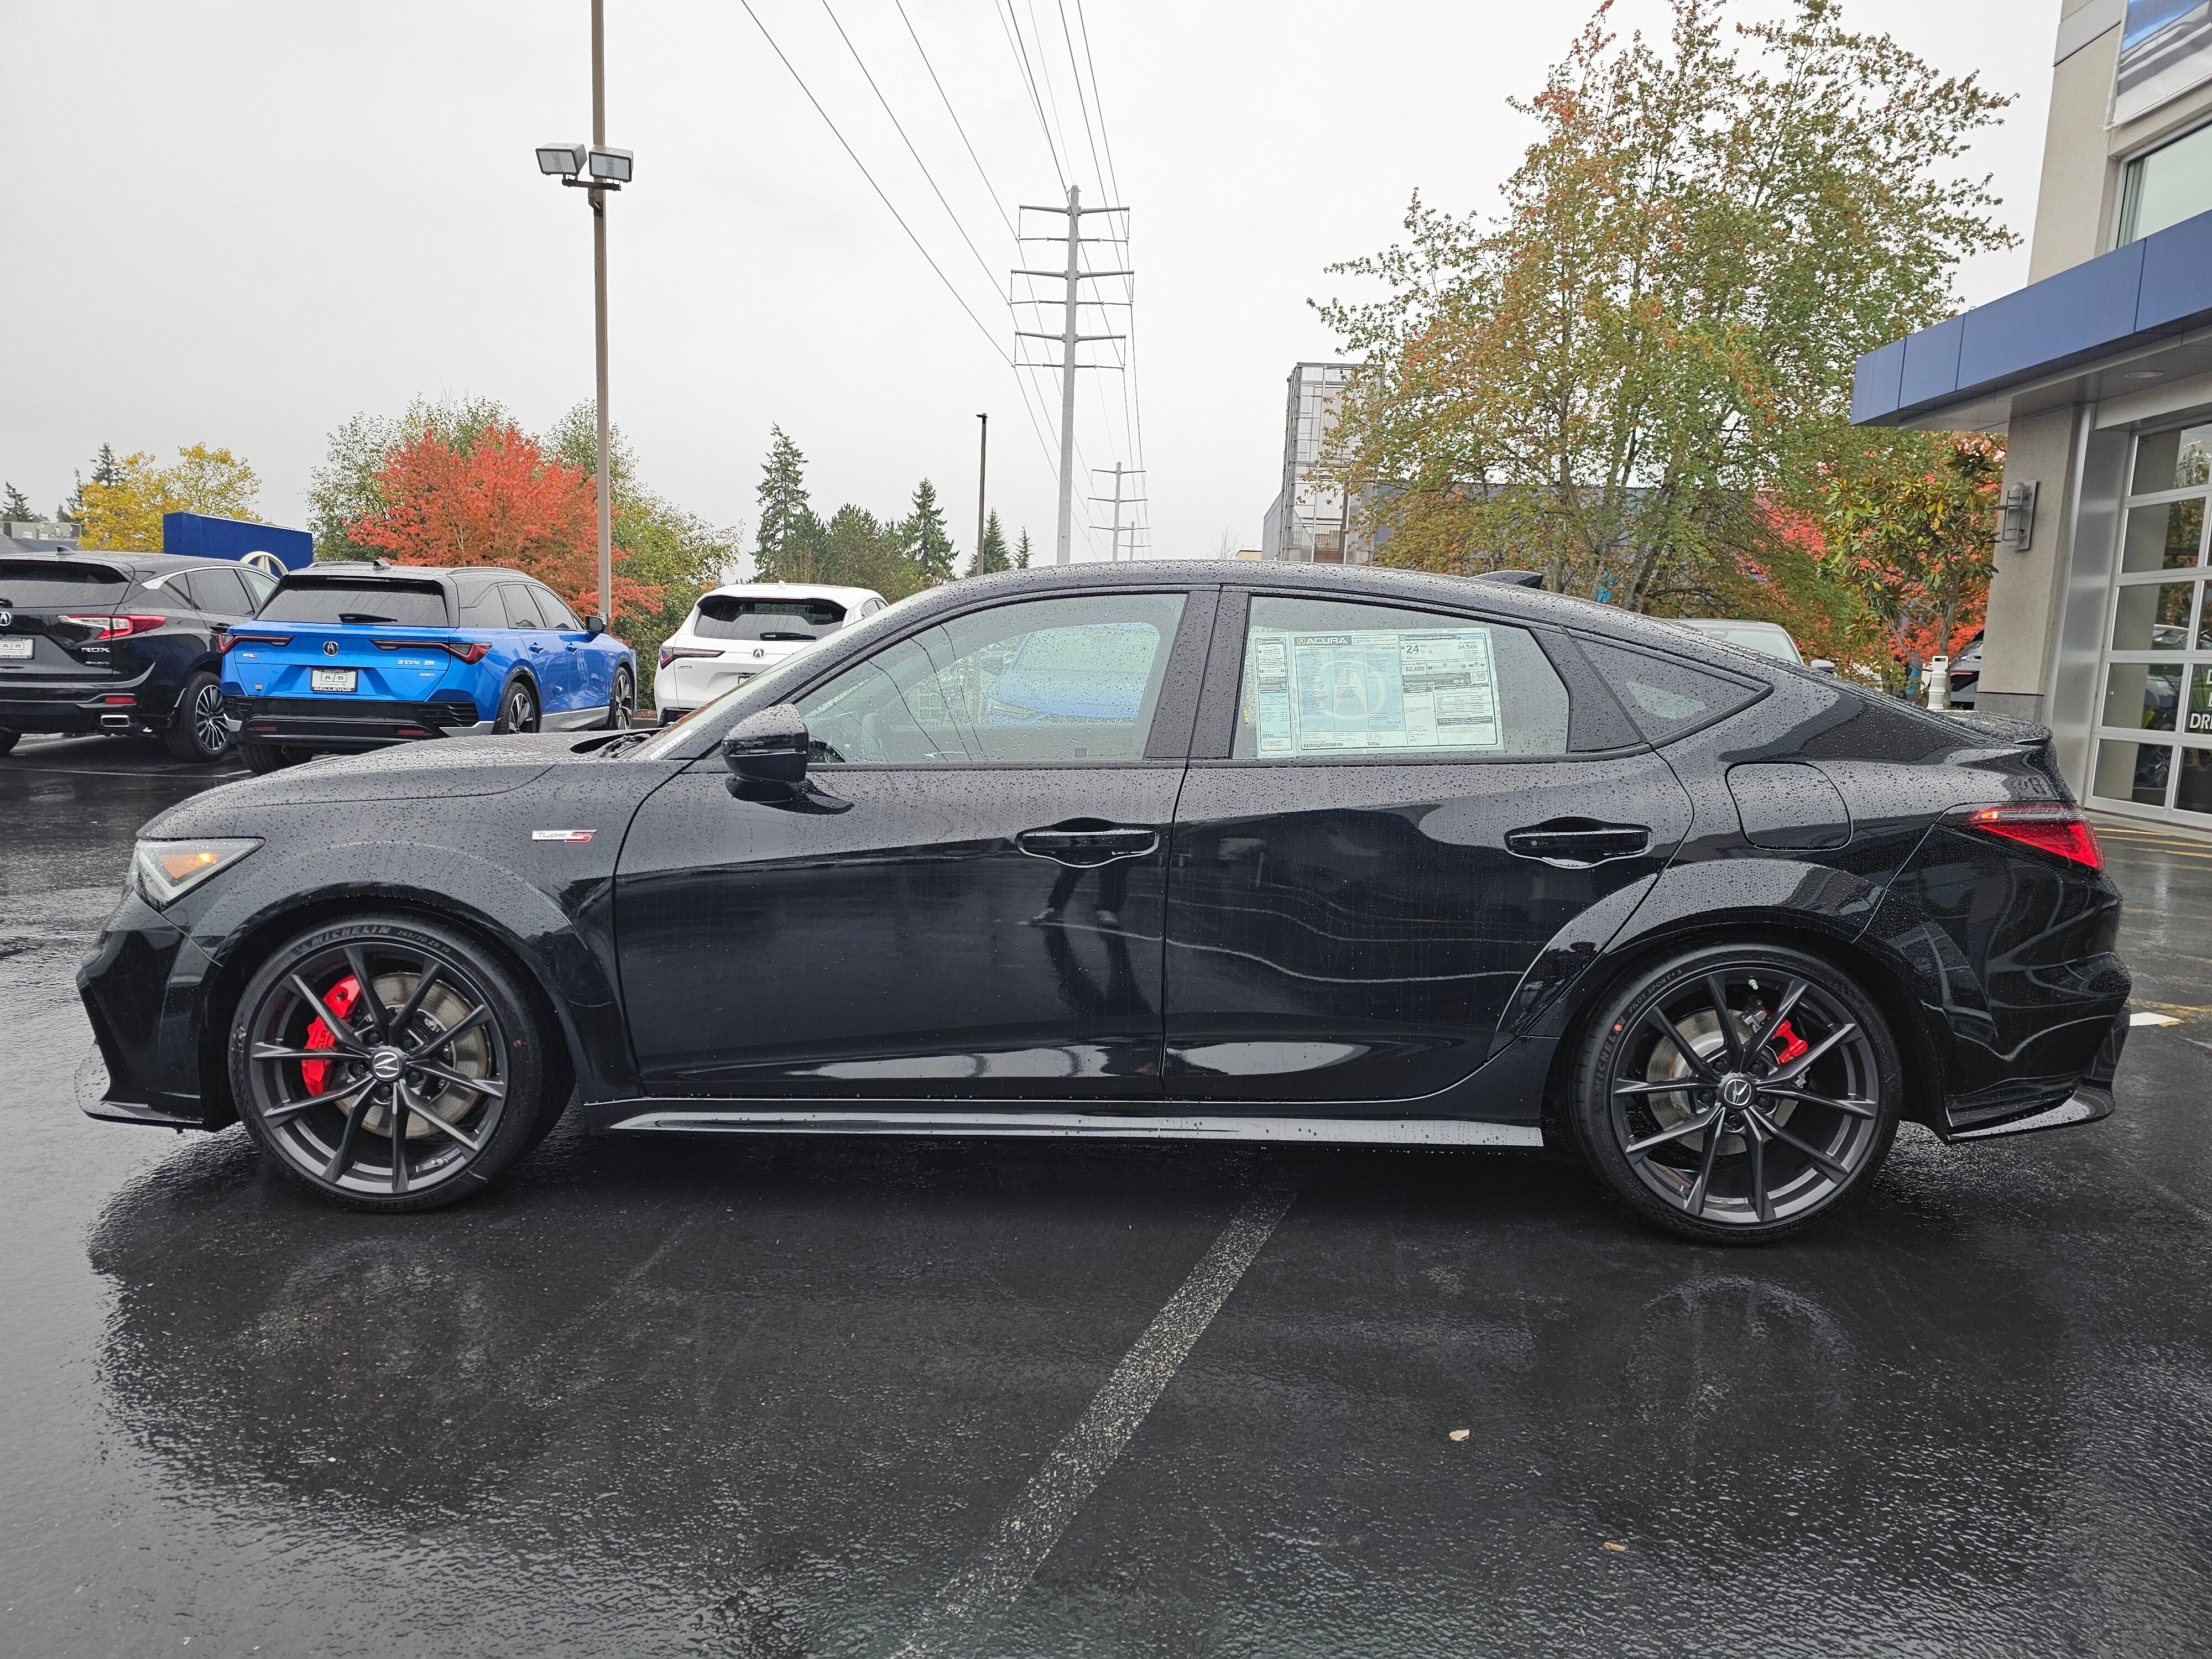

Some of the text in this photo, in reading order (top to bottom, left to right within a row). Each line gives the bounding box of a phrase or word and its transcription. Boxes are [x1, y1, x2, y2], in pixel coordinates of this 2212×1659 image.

[1406, 645, 1419, 654] 24
[564, 830, 597, 842] S
[311, 926, 390, 947] MICHELIN
[397, 930, 427, 942] 265/30
[1594, 1016, 1626, 1091] MICHELN
[1628, 993, 1646, 1013] PILOT
